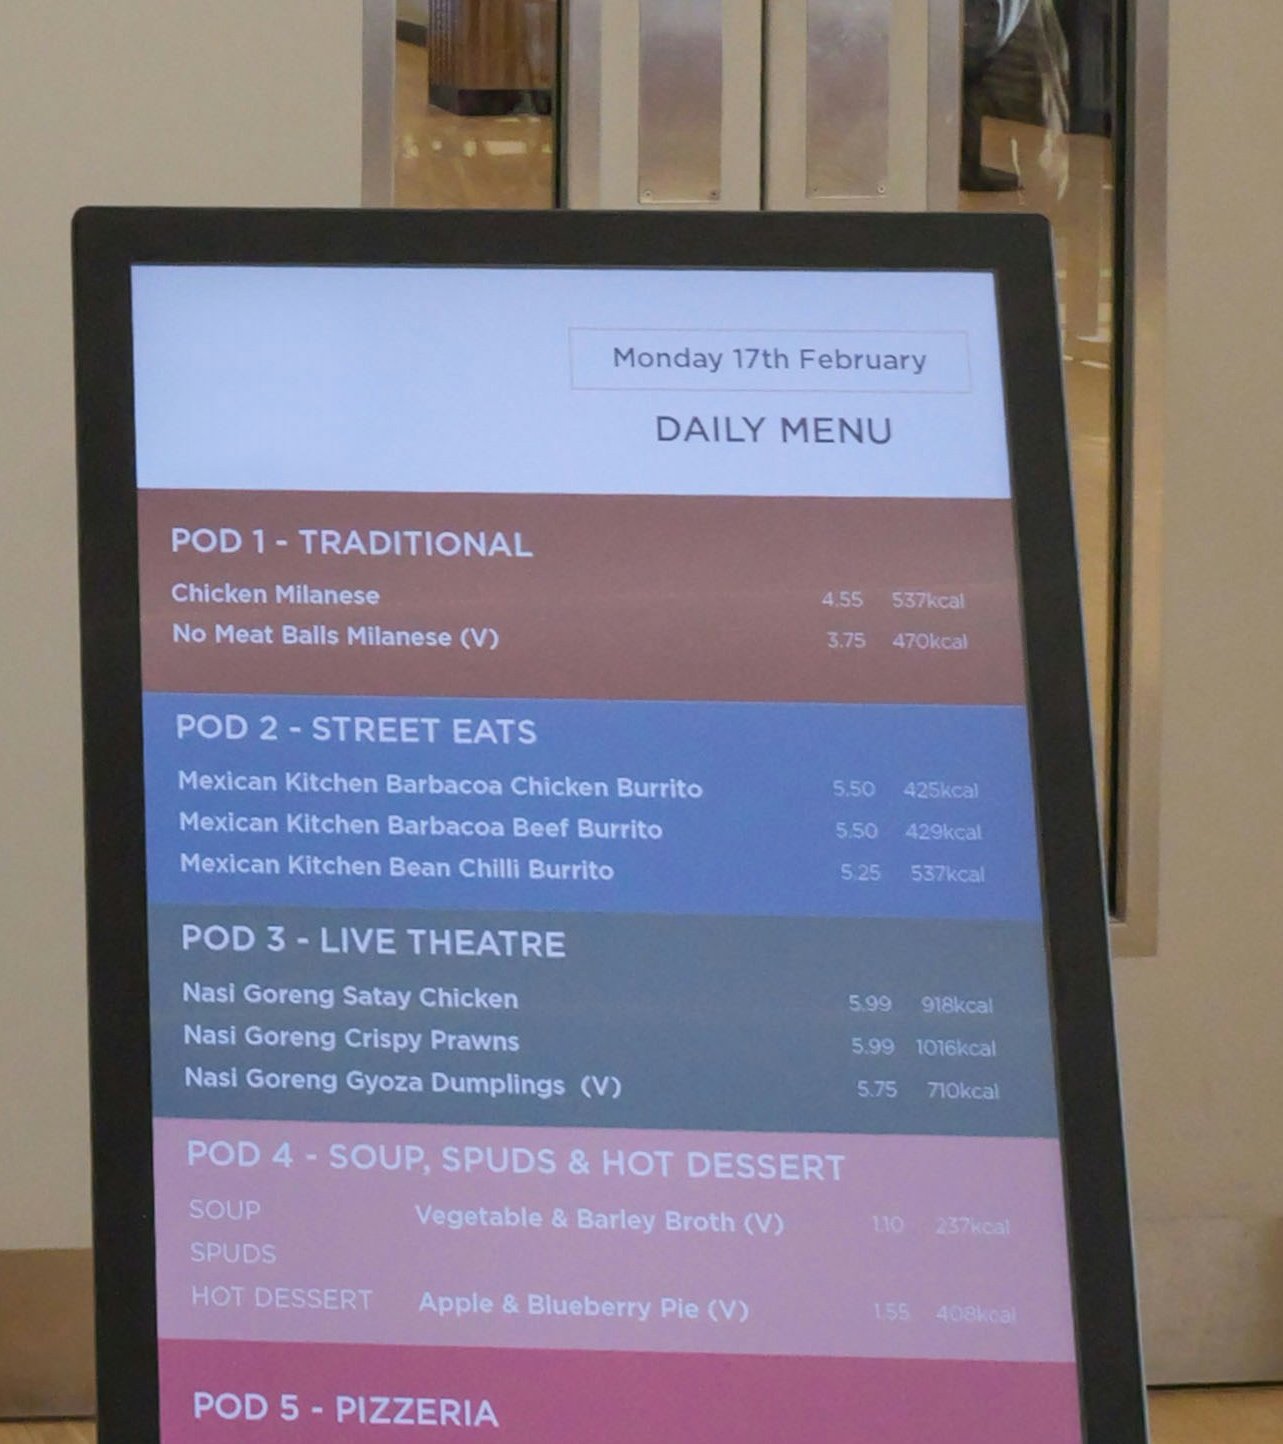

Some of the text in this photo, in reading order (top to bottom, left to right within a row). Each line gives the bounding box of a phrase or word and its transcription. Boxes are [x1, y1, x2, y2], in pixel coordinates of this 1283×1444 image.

[613, 346, 927, 375] Monday 17th February
[656, 415, 892, 445] DAILY MENU
[171, 527, 243, 554] POD
[252, 528, 264, 554] 1
[298, 529, 534, 558] TRADITIONAL
[171, 582, 381, 606] Chicken Milanese
[172, 623, 500, 650] No Meat Balls Milanese (V)
[176, 713, 248, 740] POD
[259, 714, 278, 740] 2
[312, 715, 441, 743] STREET
[452, 718, 537, 745] EATS
[178, 770, 704, 799] Mexican Kitchen Barbacoa Chicken Burrito
[182, 924, 256, 952] POD
[267, 925, 286, 952] 3
[321, 926, 397, 954] LIVE
[406, 928, 566, 959] THEATRE
[183, 981, 519, 1011] Nasi Goreng Satay Chicken
[185, 1066, 622, 1099] Nasi Goreng Gyoza Dumplings (V)
[188, 1139, 261, 1167] POD
[272, 1142, 294, 1168] 4
[329, 1143, 431, 1176] SOUP,
[442, 1145, 557, 1175] SPUDS
[568, 1148, 590, 1175] &
[602, 1149, 675, 1178] HOT
[687, 1150, 846, 1181] DESSERT
[194, 1391, 269, 1421] POD
[280, 1393, 300, 1422] 5
[336, 1396, 500, 1428] PIZZERIA
